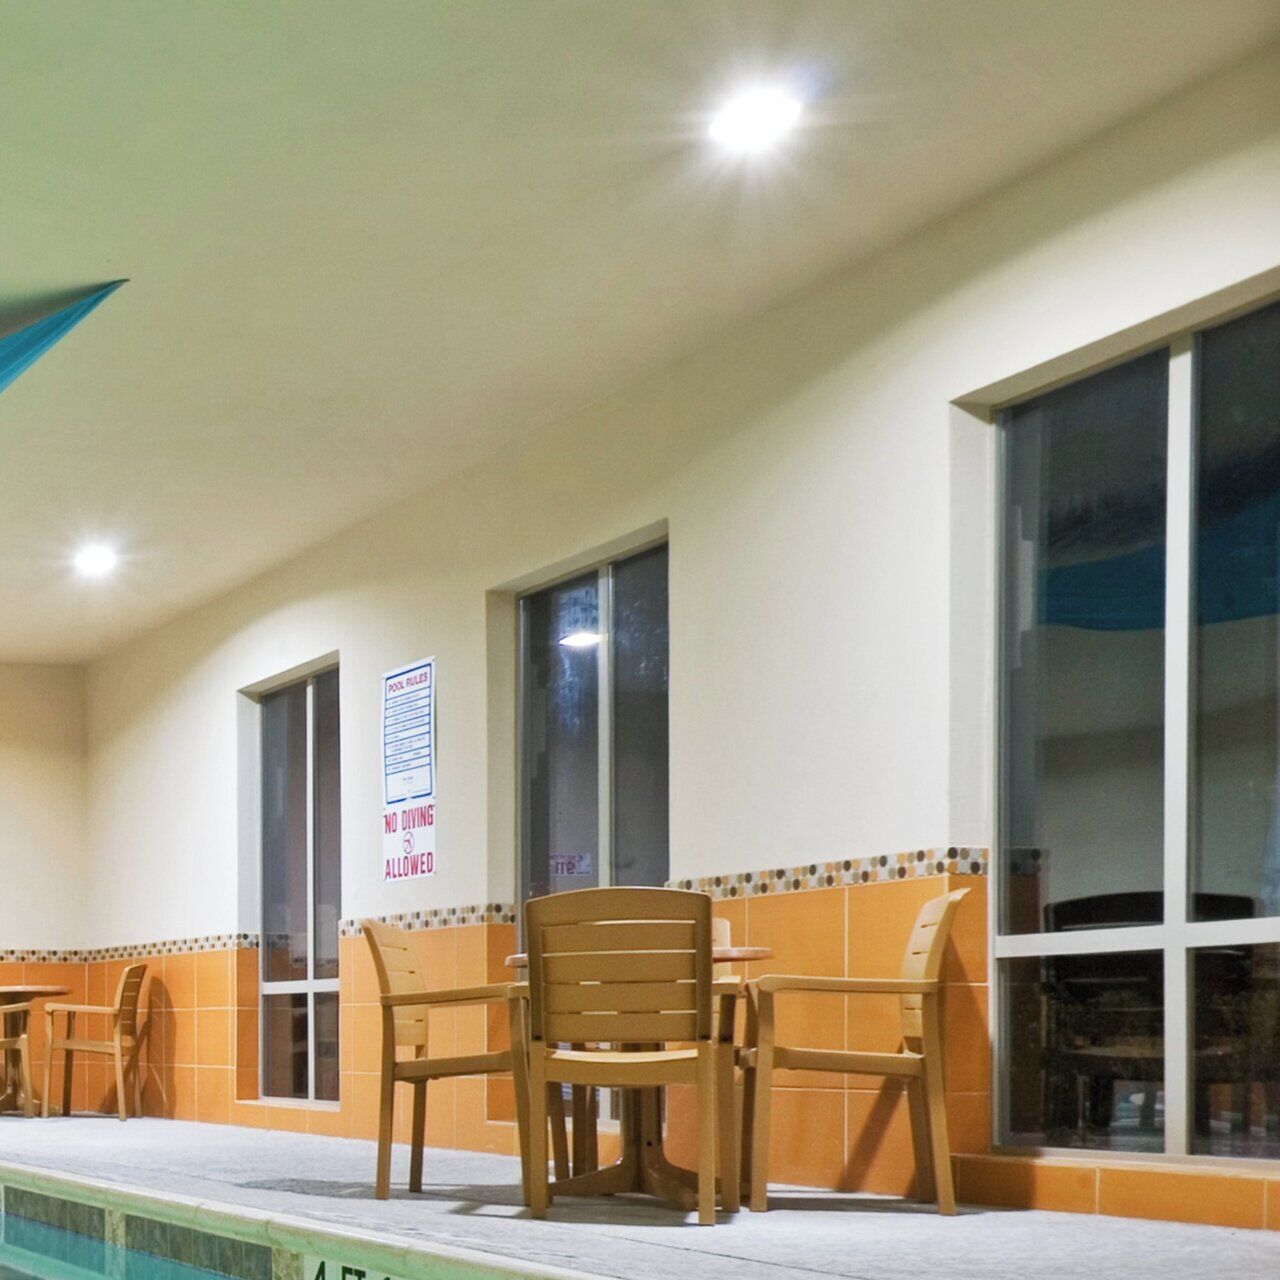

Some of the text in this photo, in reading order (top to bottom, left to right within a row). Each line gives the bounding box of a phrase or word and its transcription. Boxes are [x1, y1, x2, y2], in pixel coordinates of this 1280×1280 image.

[388, 672, 428, 694] POOL RULES
[385, 804, 433, 834] NO DIVING
[385, 851, 433, 879] ALLOWED
